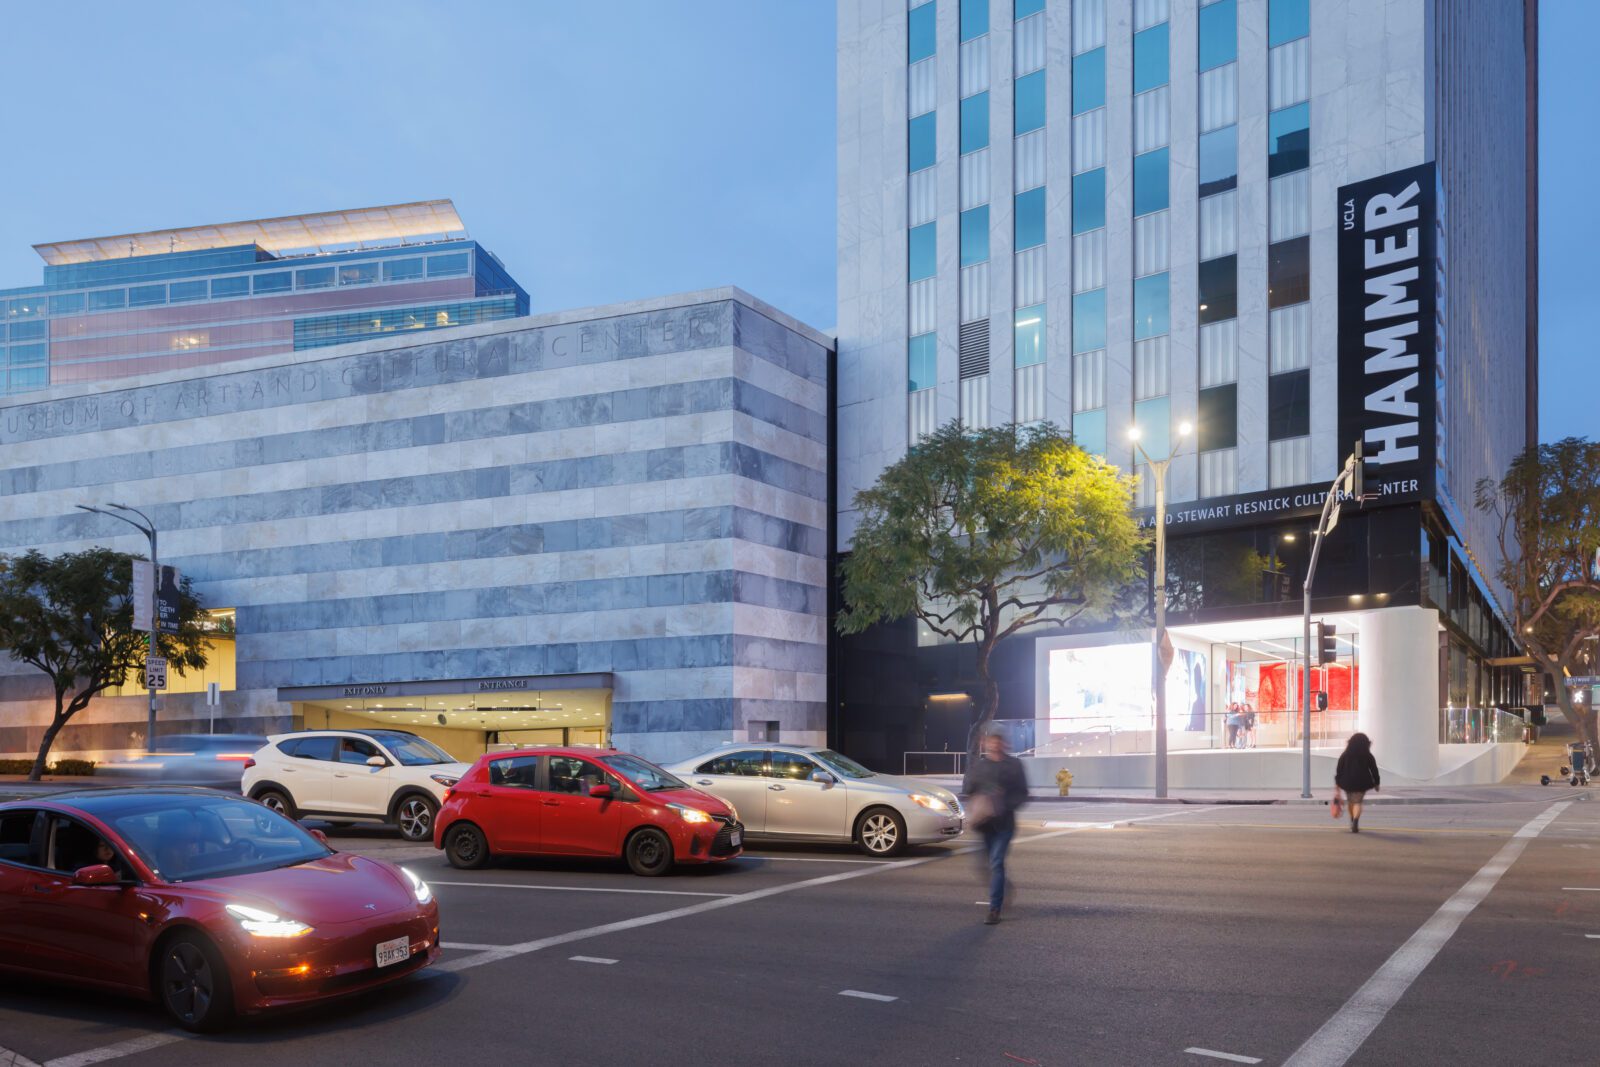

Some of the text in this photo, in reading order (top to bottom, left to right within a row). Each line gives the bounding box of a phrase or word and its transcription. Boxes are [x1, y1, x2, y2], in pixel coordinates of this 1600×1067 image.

[1344, 198, 1355, 231] UCLA
[1364, 180, 1421, 465] HAMMER
[120, 396, 153, 418] OF
[175, 384, 231, 411] ART
[252, 374, 317, 401] AND
[341, 341, 528, 386] CULTURAL
[551, 317, 705, 358] CENTER
[1149, 514, 1173, 527] AD
[1177, 504, 1231, 523] STEWART
[1235, 497, 1290, 515] RESNICK
[159, 606, 176, 614] GETH
[149, 666, 164, 674] LIMIT
[148, 674, 165, 688] 25
[478, 679, 528, 690] ENTRANCE
[343, 685, 387, 696] EXIT ONLY
